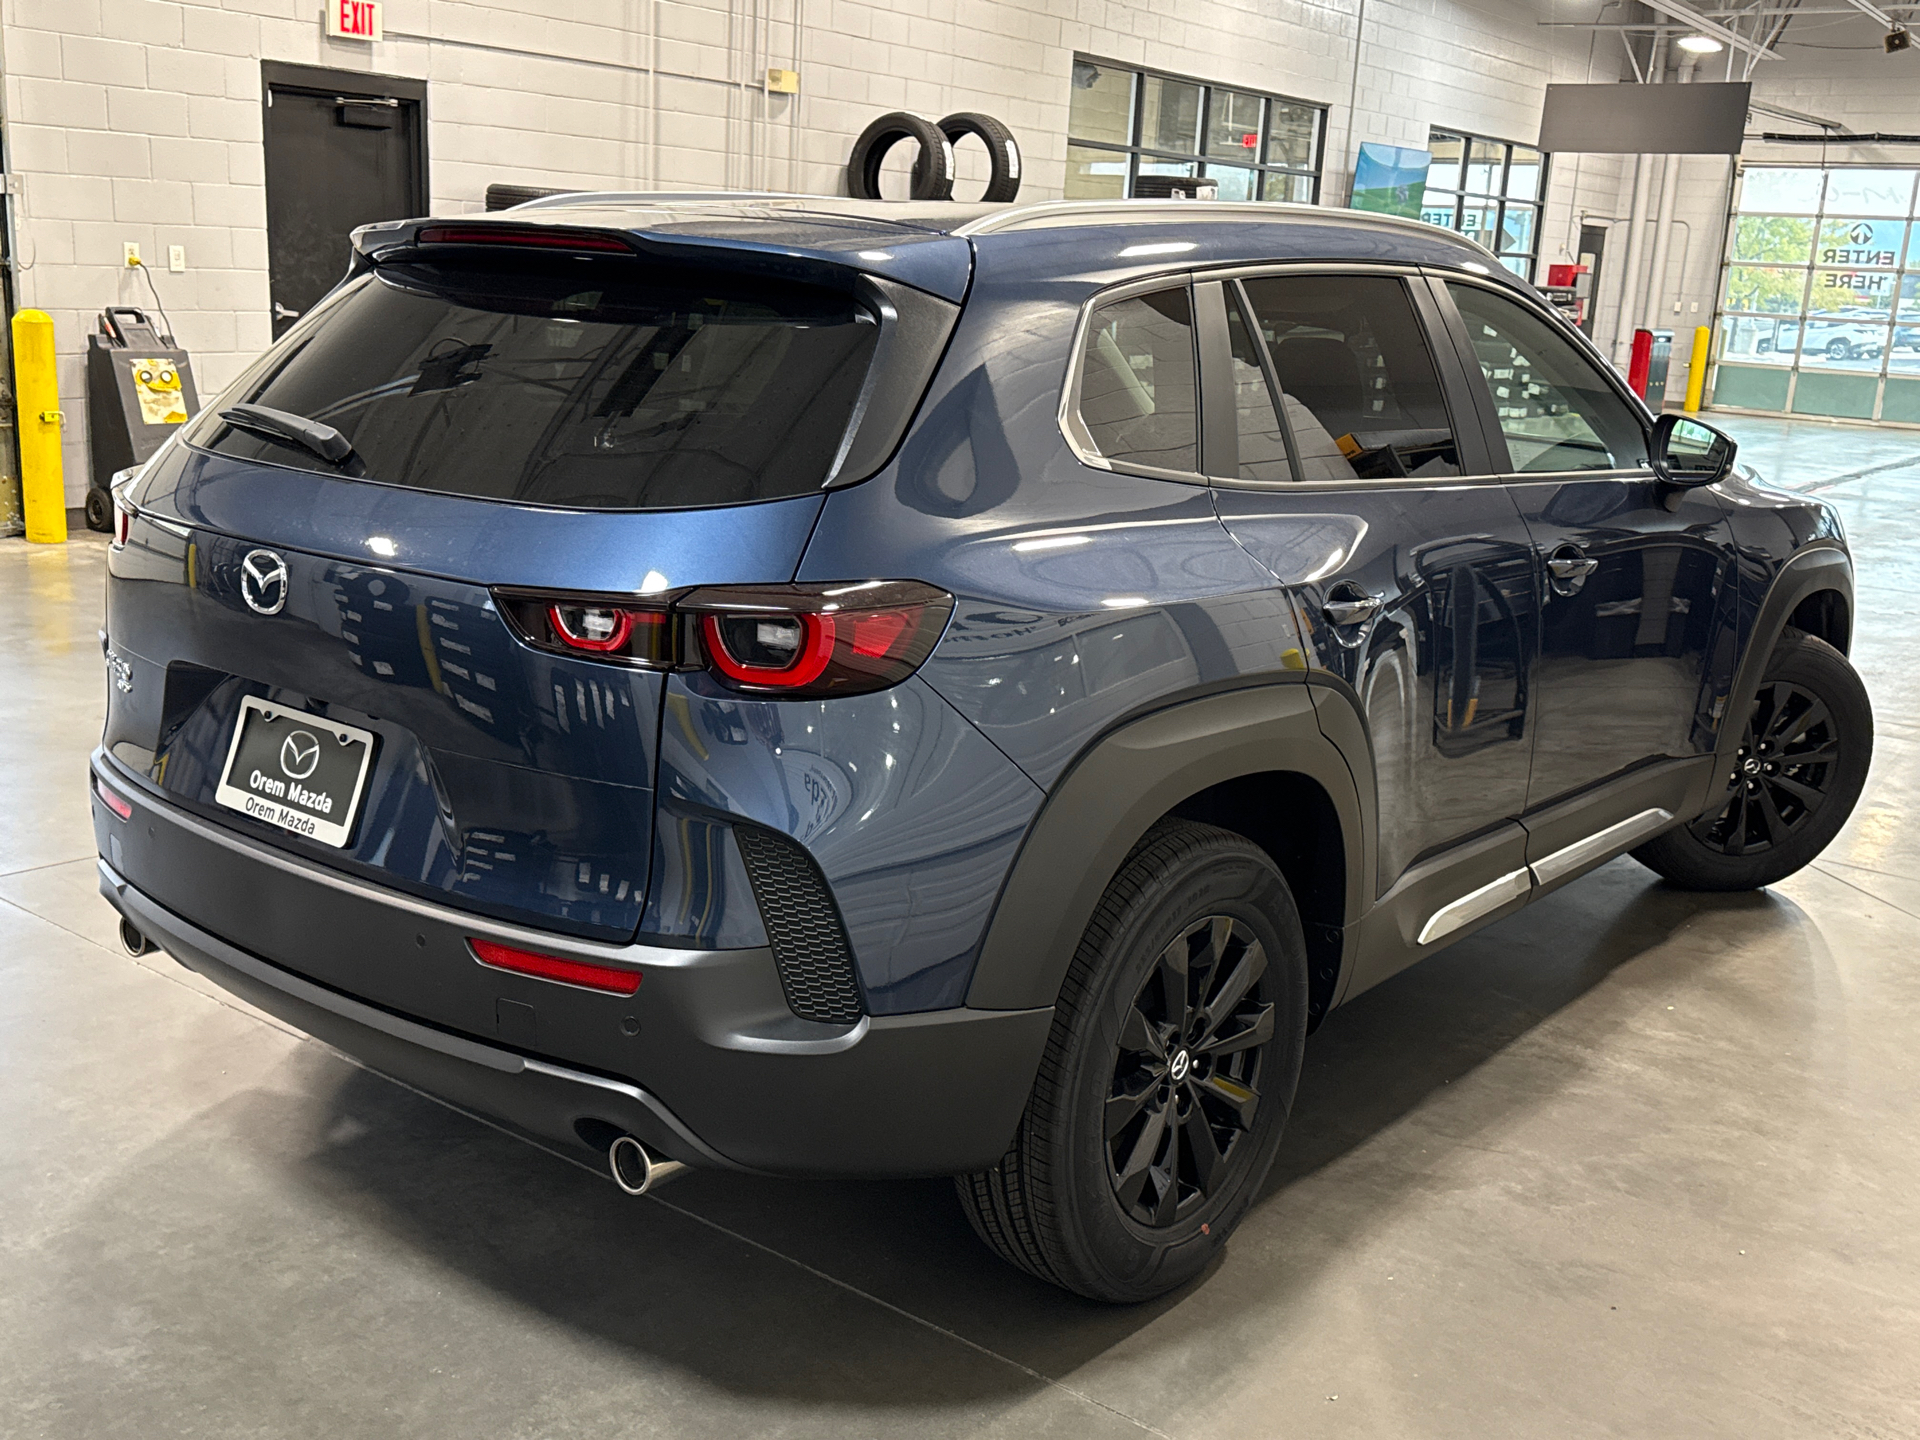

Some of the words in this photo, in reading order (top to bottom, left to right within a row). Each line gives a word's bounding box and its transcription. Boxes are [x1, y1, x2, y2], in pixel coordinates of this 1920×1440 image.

[340, 0, 375, 36] EXIT
[250, 769, 286, 798] Orem
[287, 782, 333, 814] Mazda
[245, 796, 276, 821] Orem
[277, 809, 316, 836] Mazda
